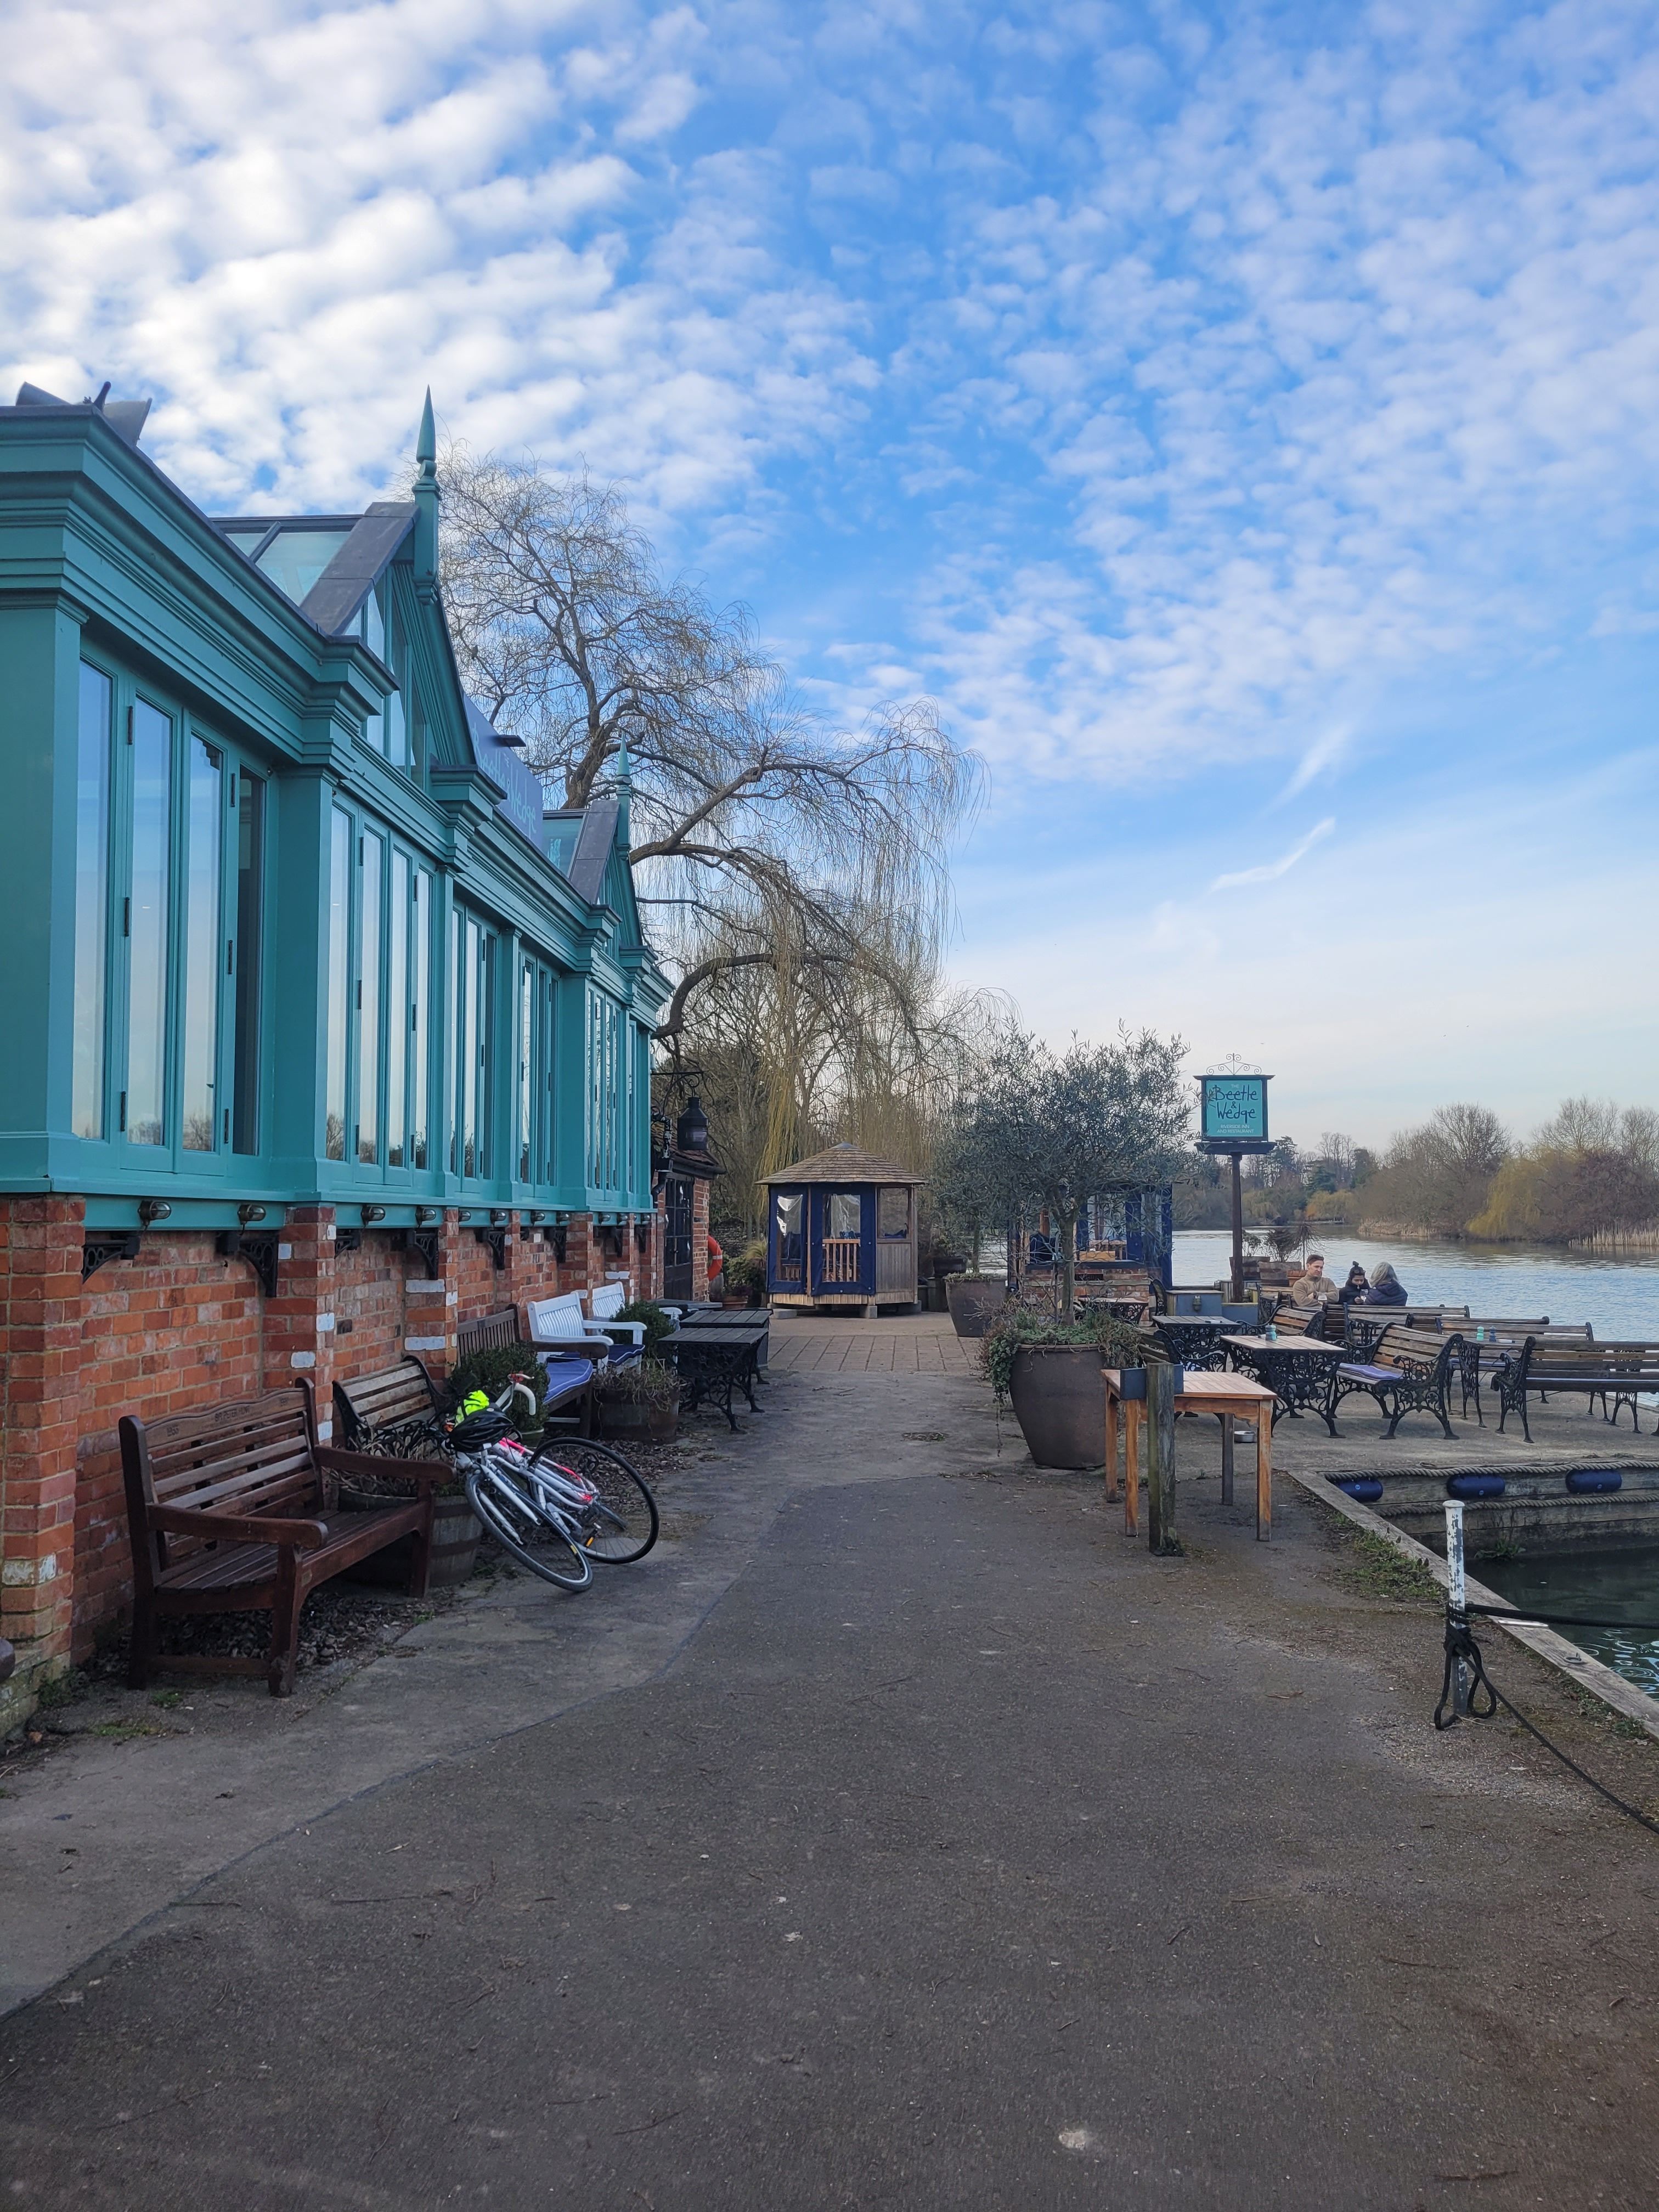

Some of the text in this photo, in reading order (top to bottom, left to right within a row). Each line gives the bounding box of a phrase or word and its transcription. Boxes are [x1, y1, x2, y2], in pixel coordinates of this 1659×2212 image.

[472, 722, 505, 786] Beetle
[511, 763, 537, 838] Wedge
[1212, 1084, 1259, 1101] Beetle
[1216, 1102, 1257, 1124] Wedge
